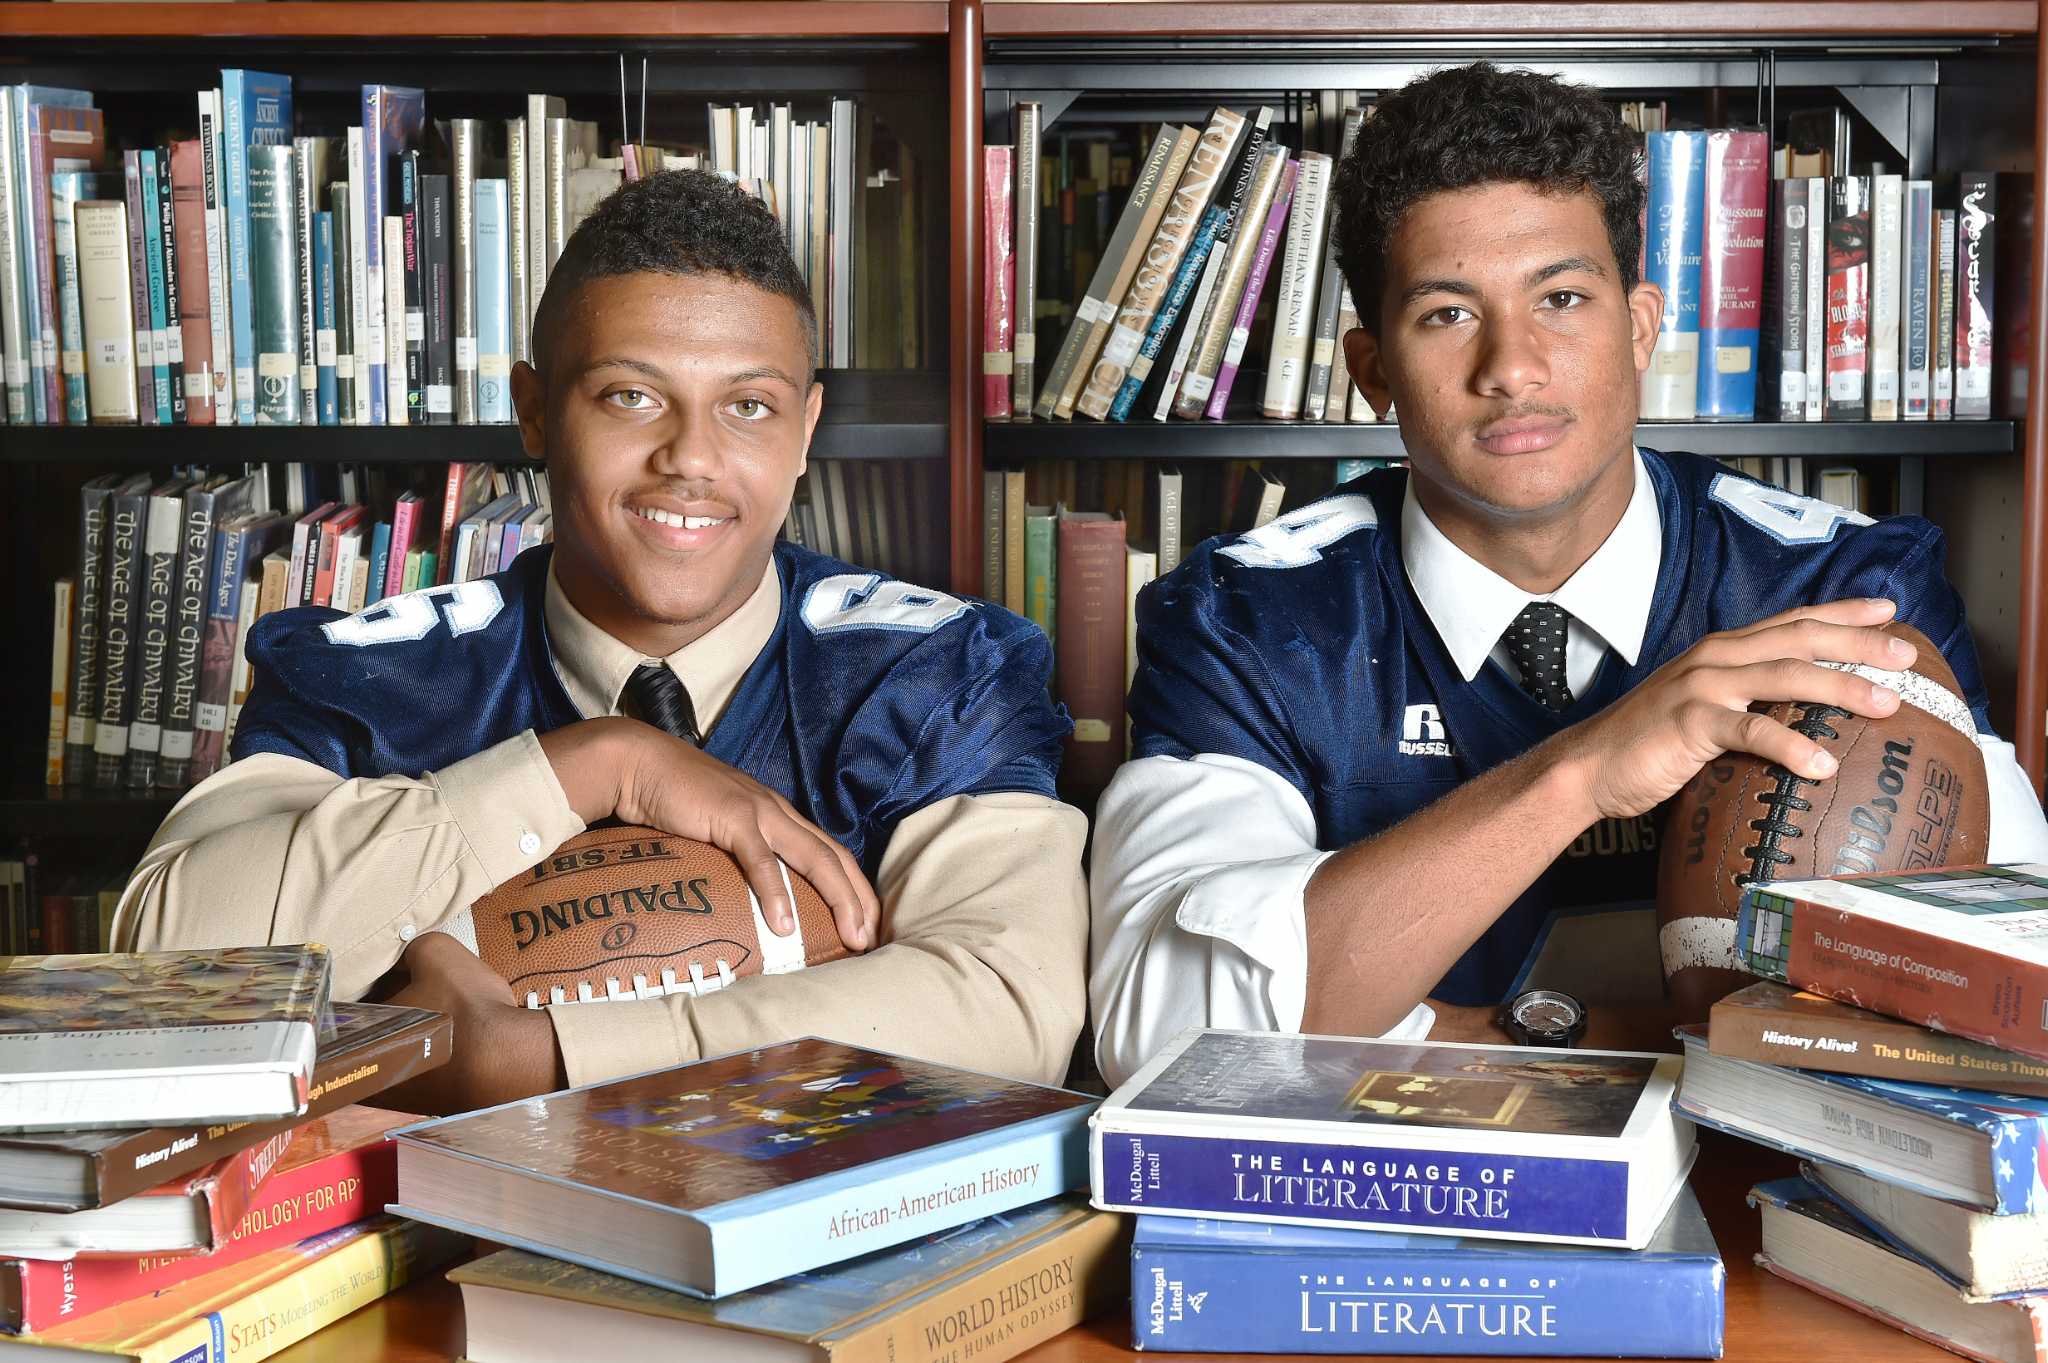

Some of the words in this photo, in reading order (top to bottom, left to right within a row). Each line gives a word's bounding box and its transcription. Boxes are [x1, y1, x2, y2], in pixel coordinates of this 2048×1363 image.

[227, 97, 241, 149] ANCIENT
[203, 121, 214, 173] EYEWITNESS
[1231, 129, 1264, 199] EYEWITNESS
[206, 174, 215, 203] BOOKS
[230, 151, 242, 197] GREECE
[1129, 136, 1174, 209] RENAISSANCE
[1152, 137, 1192, 209] RENAISSANCE
[1306, 160, 1321, 189] THE
[404, 212, 414, 229] The
[1218, 198, 1240, 240] BOOKS
[1263, 228, 1275, 246] Life
[1292, 192, 1318, 284] ELIZABETHAN
[133, 236, 143, 254] The
[149, 237, 160, 274] Ancient
[404, 229, 415, 254] Trojan
[1252, 245, 1270, 277] During
[1790, 240, 1801, 259] THE
[133, 257, 144, 275] Age
[136, 277, 145, 287] of
[300, 247, 312, 309] ANCIENT
[406, 254, 416, 273] War
[1080, 111, 1243, 419] RENAISSACE
[1169, 251, 1204, 308] Renaissance
[151, 276, 161, 313] Greece
[1249, 275, 1261, 292] the
[1143, 304, 1179, 361] Exploration
[1911, 288, 1925, 339] RAVEN
[302, 312, 313, 366] GREECE
[1788, 317, 1801, 350] STORM
[1166, 488, 1176, 512] AGE
[226, 531, 241, 548] The
[1166, 516, 1176, 533] OF
[222, 550, 238, 578] Dark
[307, 538, 317, 564] WORLD
[216, 579, 233, 608] Ages
[302, 564, 314, 601] DISASTERS
[1403, 703, 1445, 740] R
[510, 877, 714, 951] SPALDING
[1811, 931, 1833, 949] The
[1831, 936, 1889, 968] Language
[1887, 952, 1902, 969] of
[1899, 955, 1971, 991] Composition
[1761, 1030, 1811, 1050] History
[1815, 1035, 1859, 1054] Alive!
[1873, 1044, 1900, 1060] The
[1904, 1047, 1956, 1067] United
[1960, 1053, 2007, 1074] States
[325, 1063, 379, 1092] Industrialism
[135, 1147, 170, 1170] History
[171, 1132, 199, 1156] Alive!
[208, 1126, 225, 1140] The
[1130, 1137, 1144, 1202] McDougal
[1147, 1152, 1161, 1190] Littell
[1232, 1153, 1283, 1171] THE
[1302, 1156, 1460, 1183] LANGUAGE
[1481, 1168, 1517, 1185] OF
[305, 1190, 335, 1219] FOR
[827, 1183, 976, 1240] African-American
[981, 1162, 1040, 1196] History
[1232, 1171, 1510, 1220] LITERATURE
[60, 1261, 73, 1315] Myers
[1149, 1267, 1164, 1335] McDougal
[1169, 1281, 1184, 1321] Littell
[1300, 1274, 1331, 1286] THE
[1366, 1276, 1508, 1289] LANGUAGE
[1529, 1278, 1559, 1289] OF
[230, 1312, 277, 1354] STATS
[331, 1284, 348, 1299] THE
[924, 1298, 996, 1352] WORLD
[999, 1255, 1074, 1316] HISTORY
[1299, 1291, 1557, 1337] LITERATURE
[964, 1322, 1014, 1359] HUMAN
[1020, 1289, 1076, 1329] ODYSSEY
